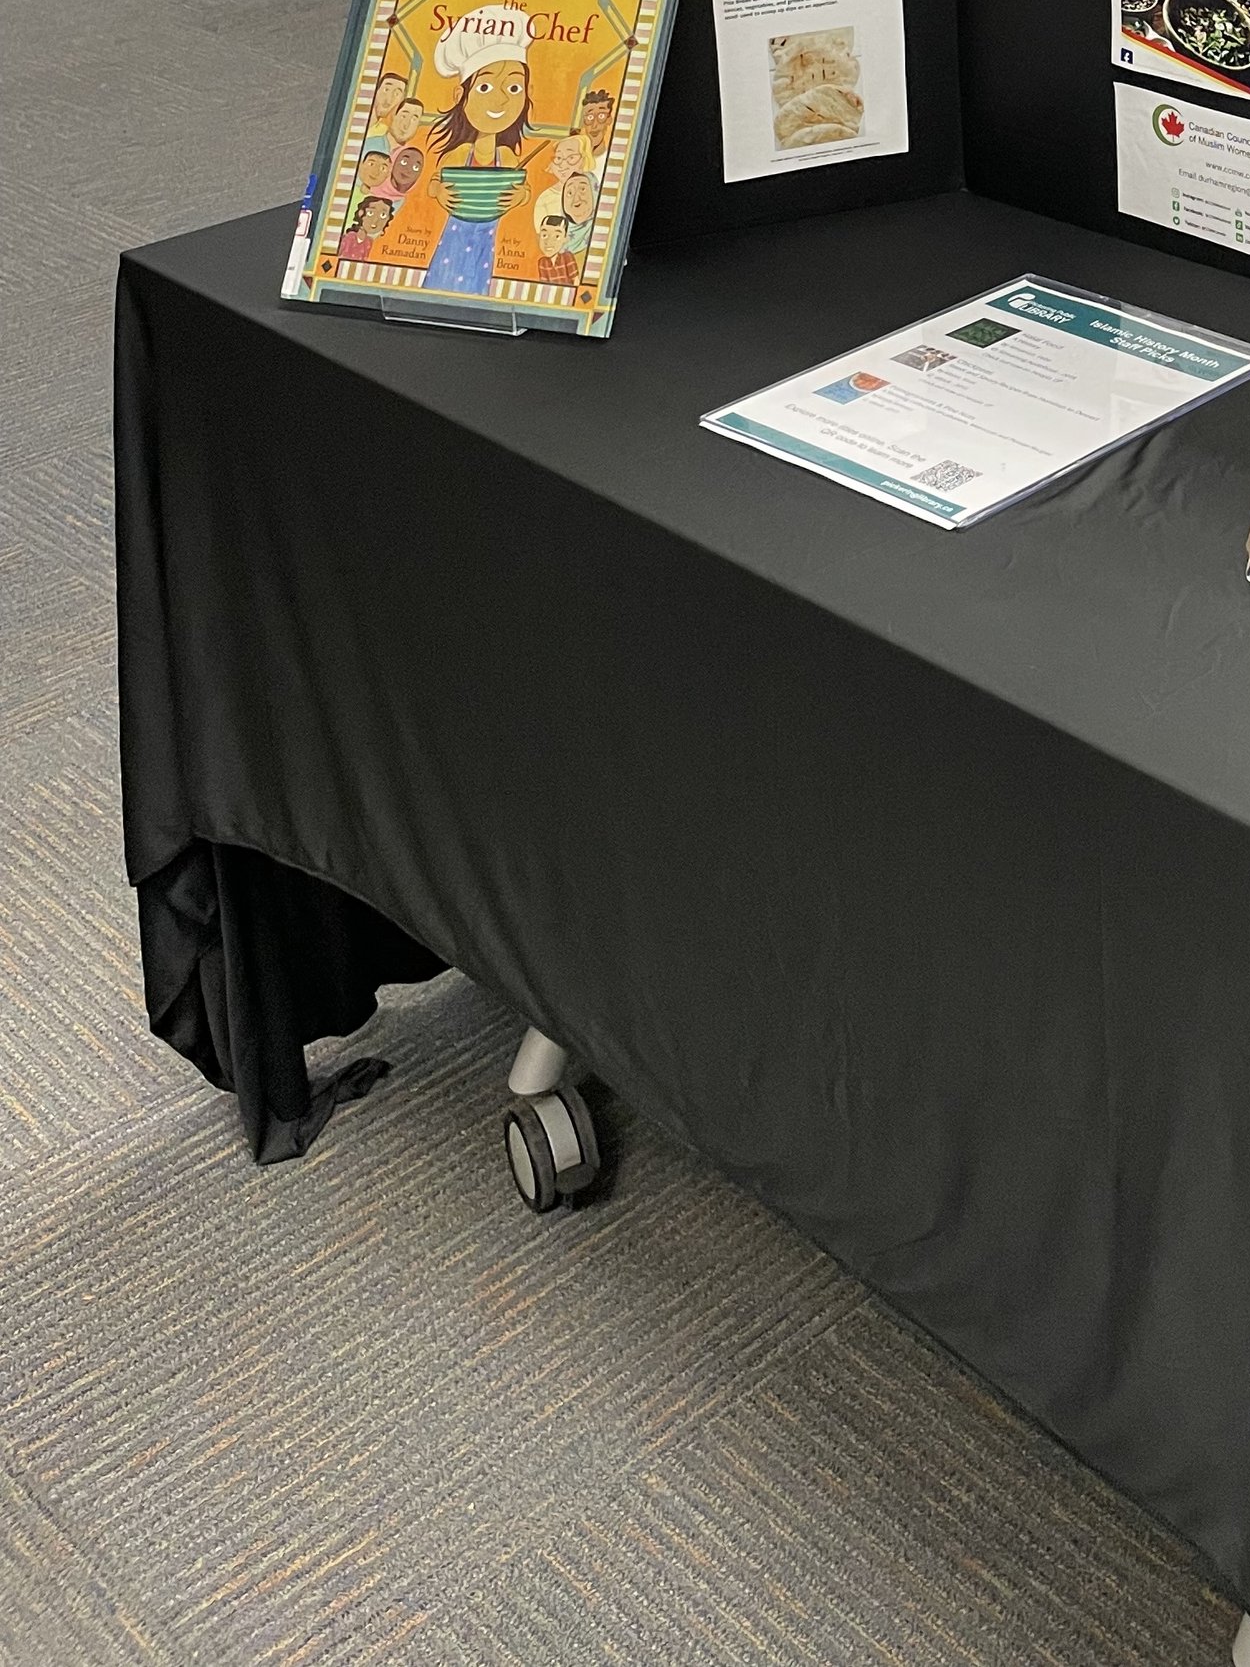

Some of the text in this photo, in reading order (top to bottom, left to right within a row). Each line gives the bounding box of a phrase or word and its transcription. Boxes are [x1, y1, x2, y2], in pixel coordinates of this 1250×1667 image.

[430, 5, 600, 44] Syrian Chef
[1188, 121, 1224, 139] Canadian
[1189, 135, 1197, 143] of
[1198, 136, 1225, 152] Muslim
[1178, 168, 1197, 180] Email
[398, 234, 430, 250] Danny
[381, 245, 426, 259] Ramadan
[498, 246, 525, 258] Anna
[497, 258, 519, 270] Bron
[1020, 303, 1071, 324] LIBRARY
[1090, 319, 1220, 368] Islamic History Month
[1109, 337, 1176, 363] Staff Picks
